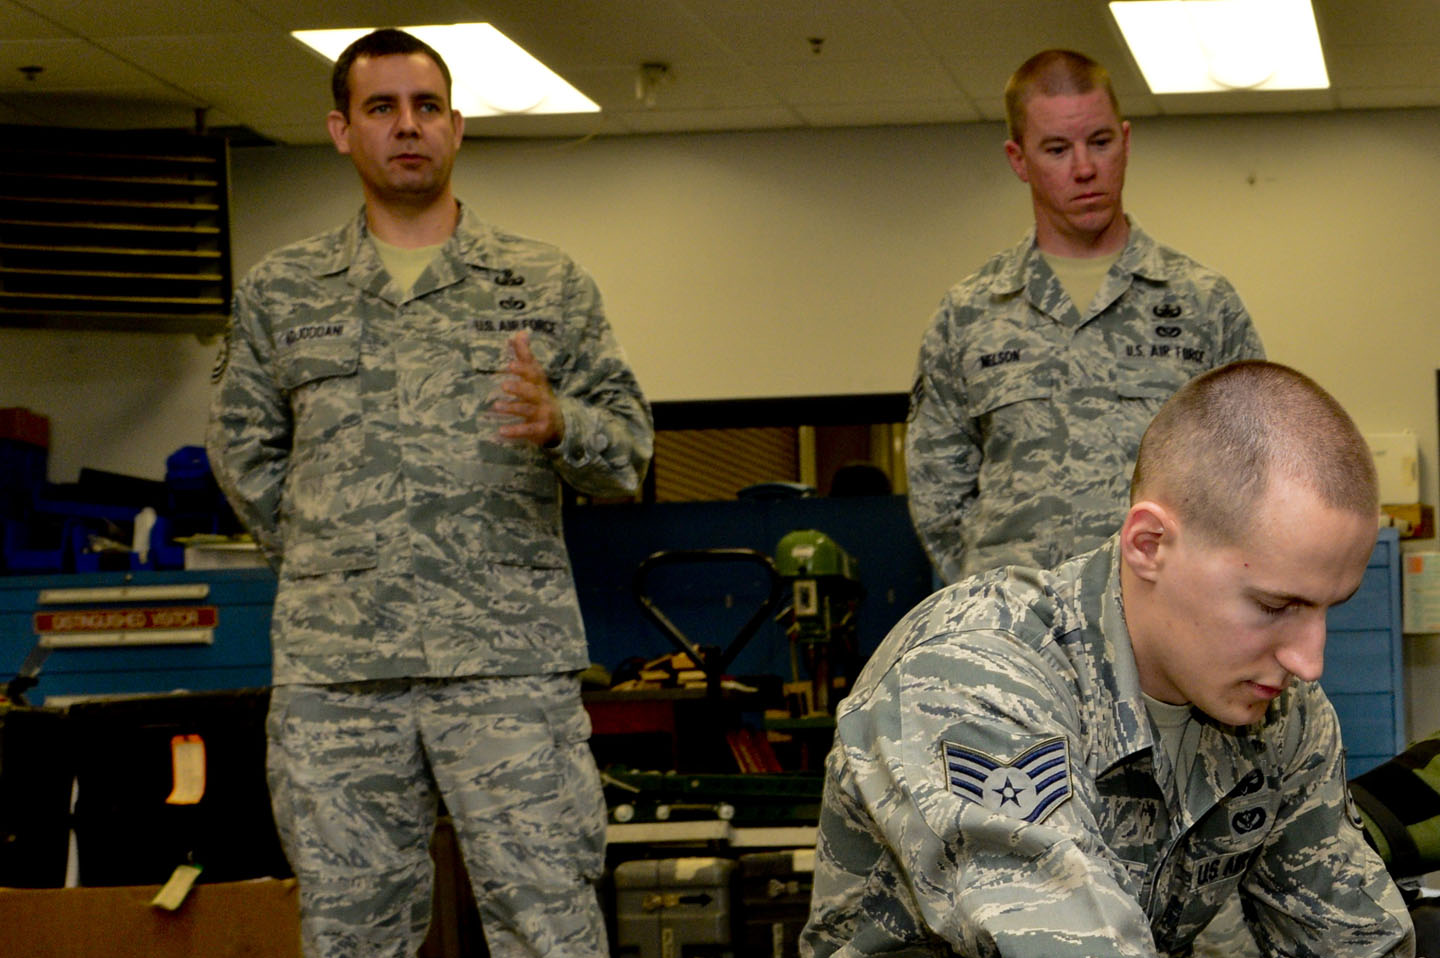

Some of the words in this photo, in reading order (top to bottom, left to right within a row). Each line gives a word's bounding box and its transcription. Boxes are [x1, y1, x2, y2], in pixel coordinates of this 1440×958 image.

[498, 319, 519, 332] AIR
[521, 318, 556, 335] FORCE
[980, 348, 1021, 368] NELSON
[1126, 344, 1146, 357] U.S.
[1150, 344, 1171, 357] AIR
[52, 612, 147, 631] DISTINGUISHED
[151, 609, 199, 628] VISITOR
